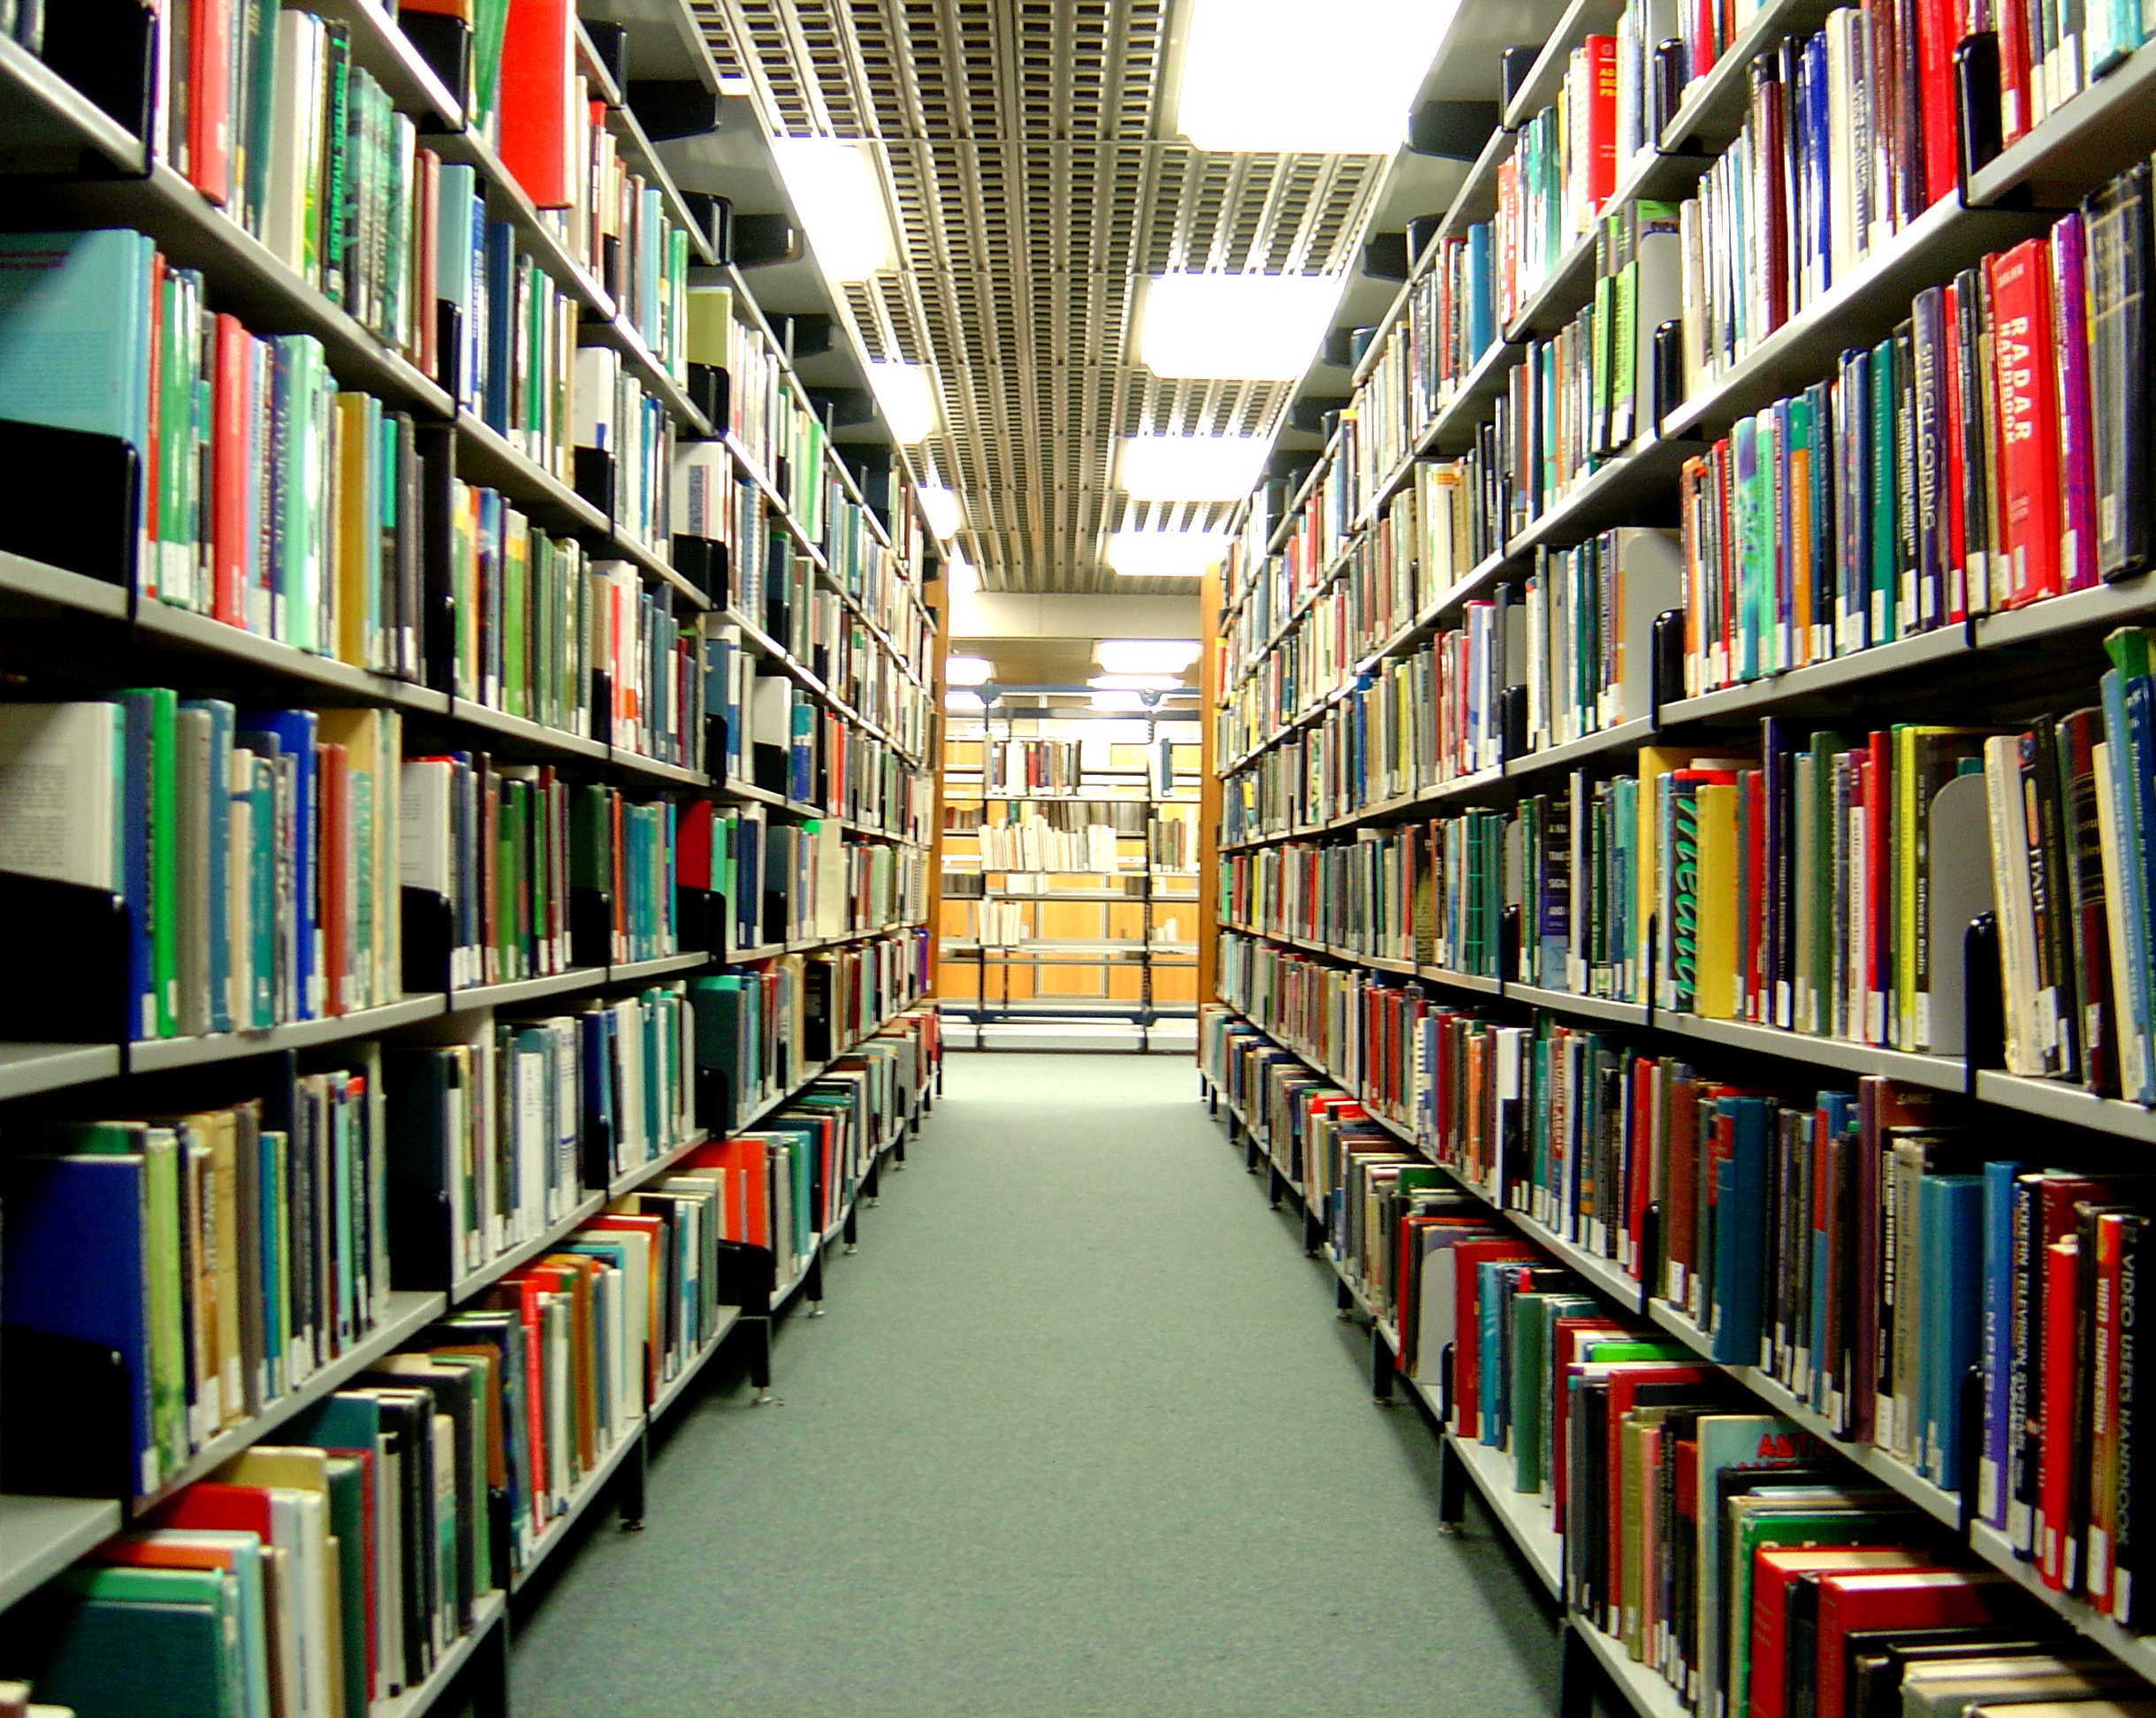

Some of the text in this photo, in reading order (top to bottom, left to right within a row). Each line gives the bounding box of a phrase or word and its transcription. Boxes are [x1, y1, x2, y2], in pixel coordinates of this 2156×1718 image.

[1917, 343, 1937, 530] SPEECH CODING
[1997, 322, 2016, 445] HANDBOOK
[2009, 315, 2034, 441] RADAR
[2015, 1190, 2030, 1450] MODERN TELEVISION SYSTEMS
[2092, 1278, 2110, 1435] VIDEO COMPRESSION
[2120, 1253, 2136, 1327] VIDEO
[2117, 1409, 2133, 1547] HANDBOOK
